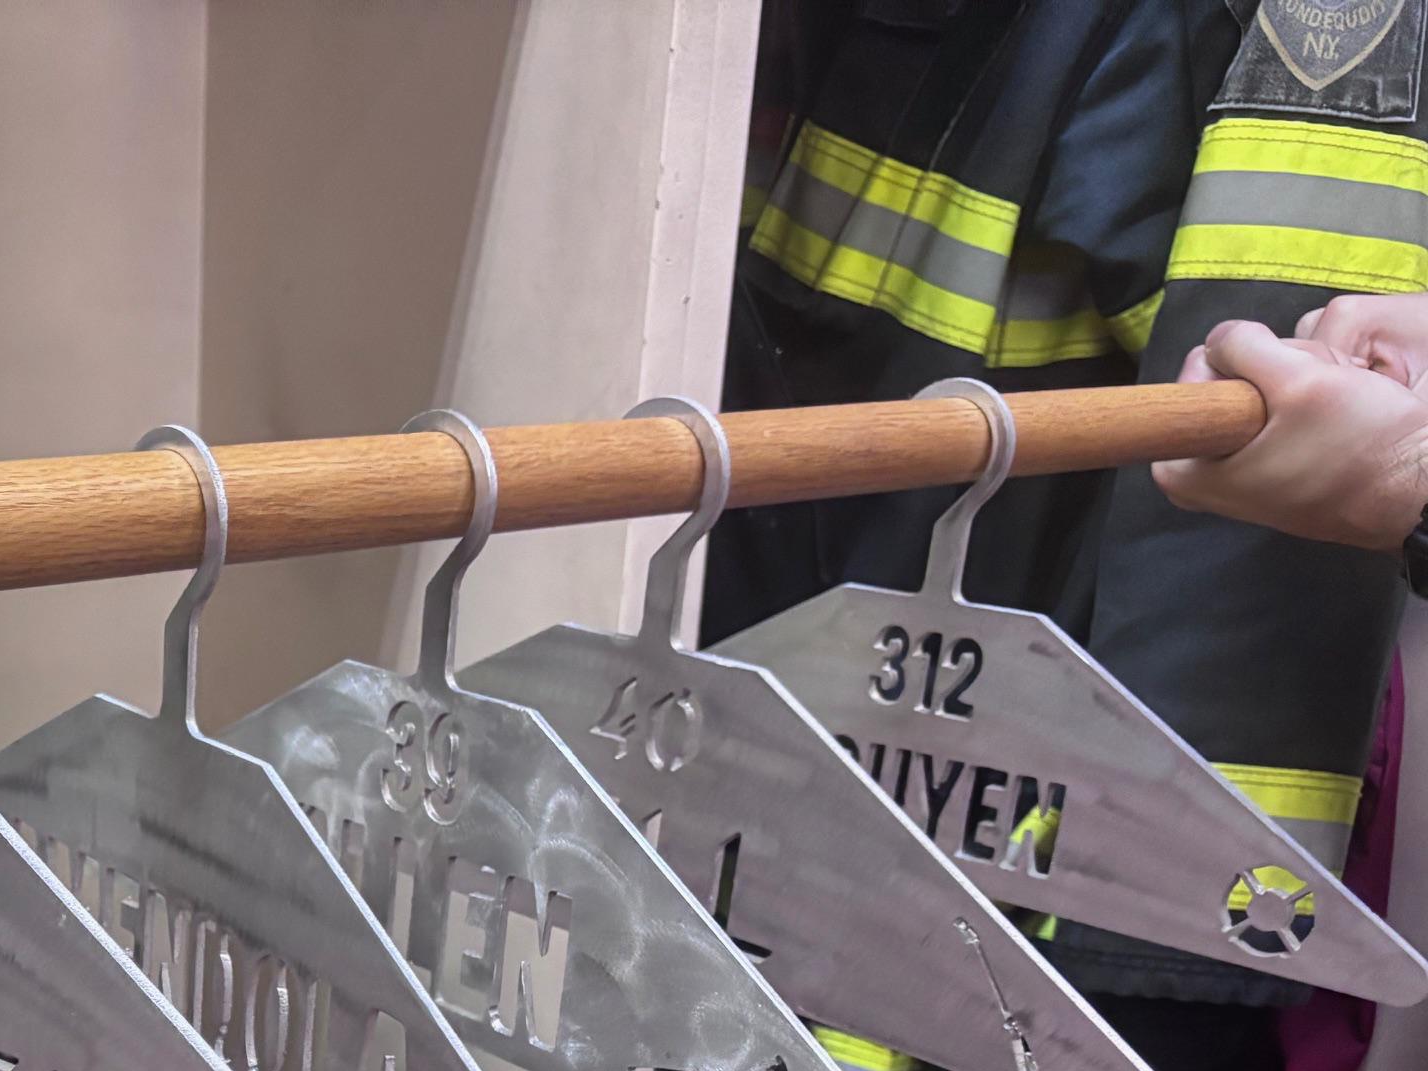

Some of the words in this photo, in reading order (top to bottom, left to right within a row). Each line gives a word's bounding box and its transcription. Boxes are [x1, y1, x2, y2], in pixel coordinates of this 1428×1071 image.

[1277, 0, 1386, 31] ONDEQUOIT
[589, 676, 704, 772] 40
[868, 625, 984, 722] 312
[381, 700, 464, 826] 39
[833, 733, 1067, 880] UYEN
[298, 802, 573, 1052] LEN
